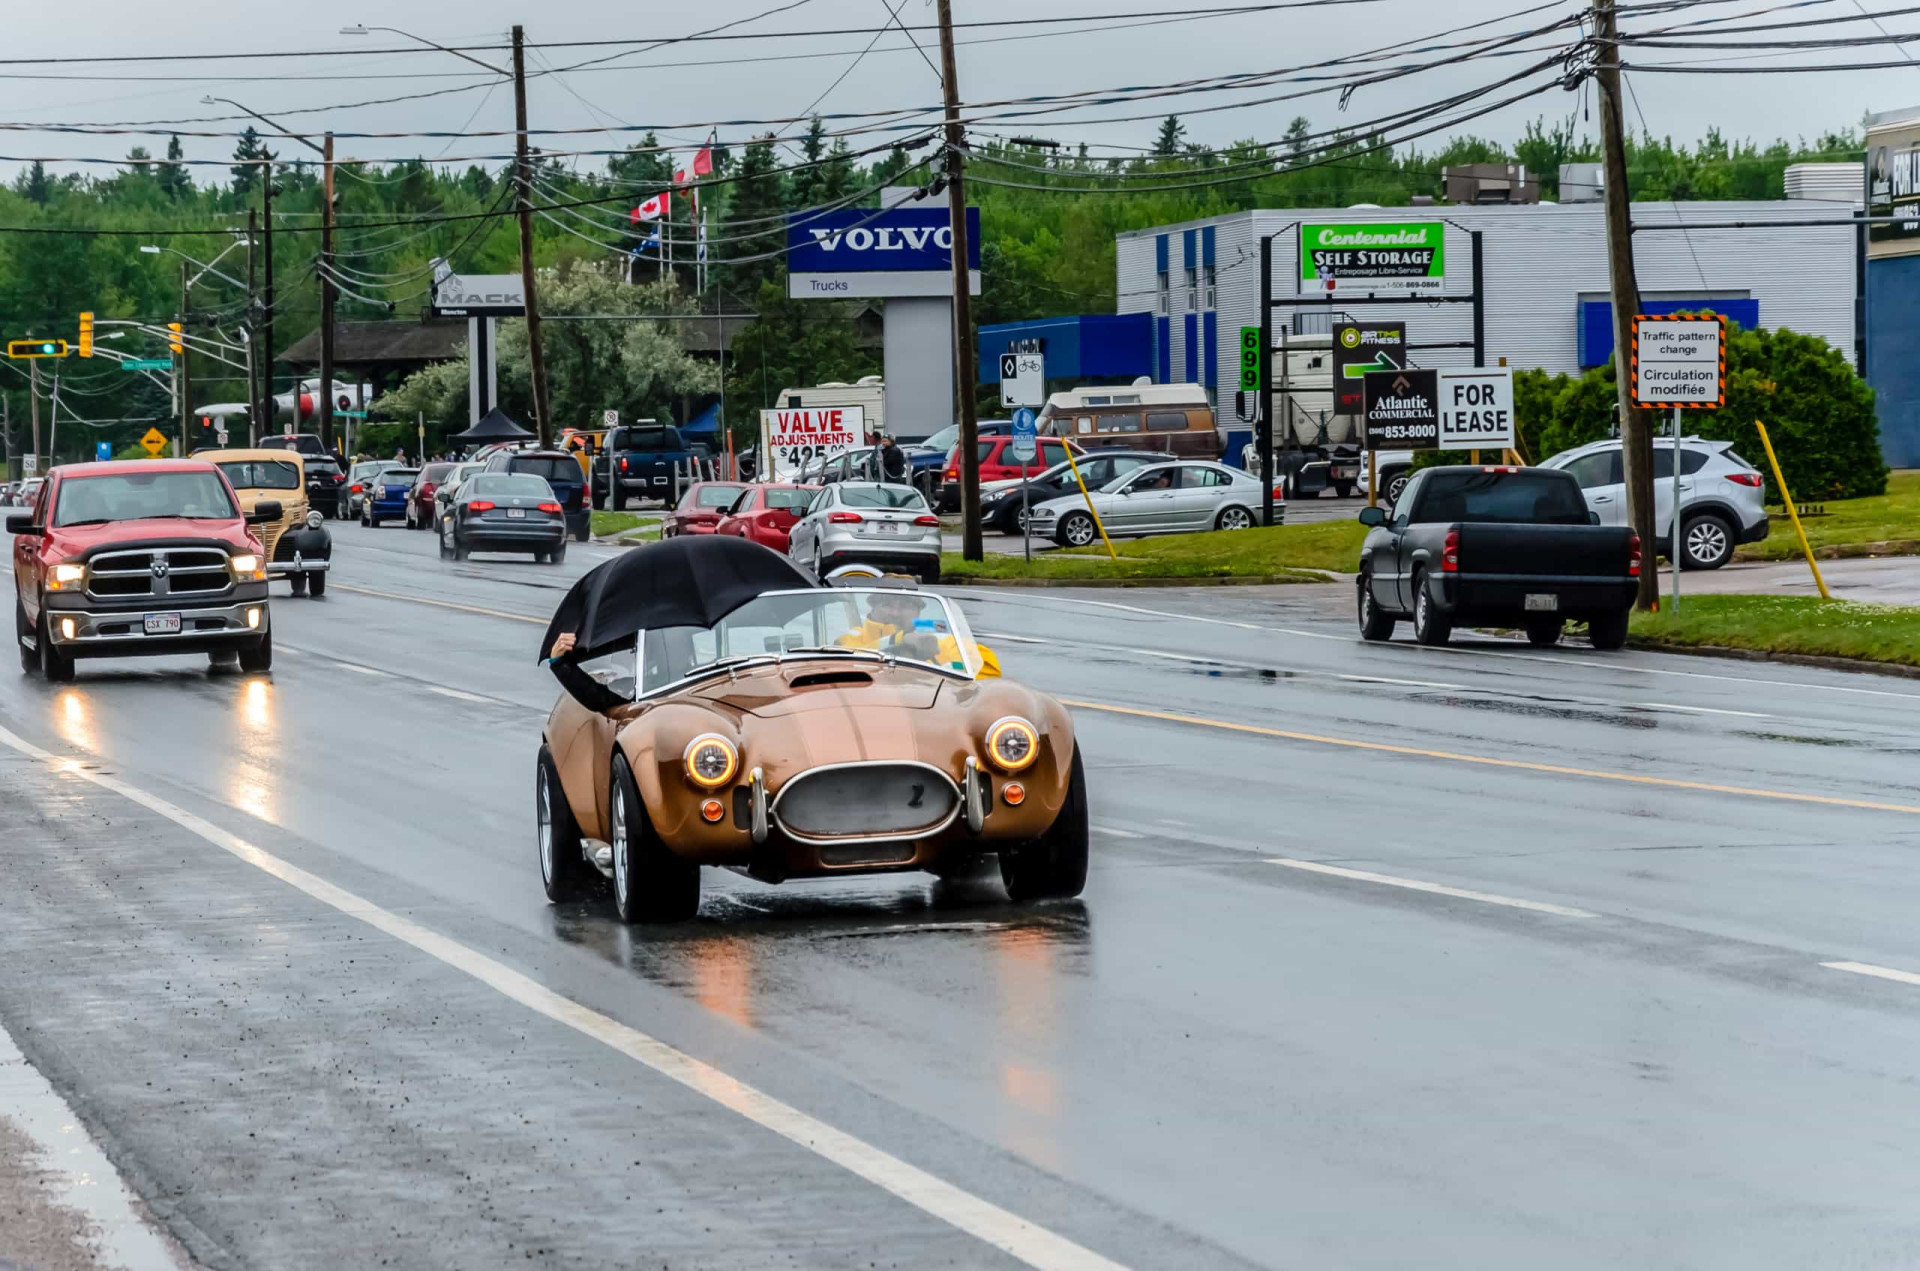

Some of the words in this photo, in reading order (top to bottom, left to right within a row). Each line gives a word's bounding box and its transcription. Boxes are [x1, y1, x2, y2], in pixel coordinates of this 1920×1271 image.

[809, 226, 952, 251] VOLVO
[1318, 229, 1427, 246] Centennial
[1334, 268, 1378, 276] Entreposage
[810, 280, 849, 291] Trucks
[441, 294, 522, 303] MACK
[1642, 332, 1675, 341] Traffic
[1678, 332, 1716, 342] pattern
[1660, 345, 1697, 355] change
[1244, 331, 1257, 387] 699
[1644, 369, 1713, 380] Circulation
[1453, 384, 1496, 406] FOR
[1651, 384, 1706, 395] modifiée
[1375, 395, 1428, 410] Atlantic
[1369, 409, 1435, 419] COMMERCIAL
[778, 410, 843, 433] VALVE
[1443, 410, 1508, 433] LEASE
[1385, 424, 1436, 438] 853-8000
[770, 432, 854, 446] ADJUSTMENTS
[165, 619, 178, 627] 790
